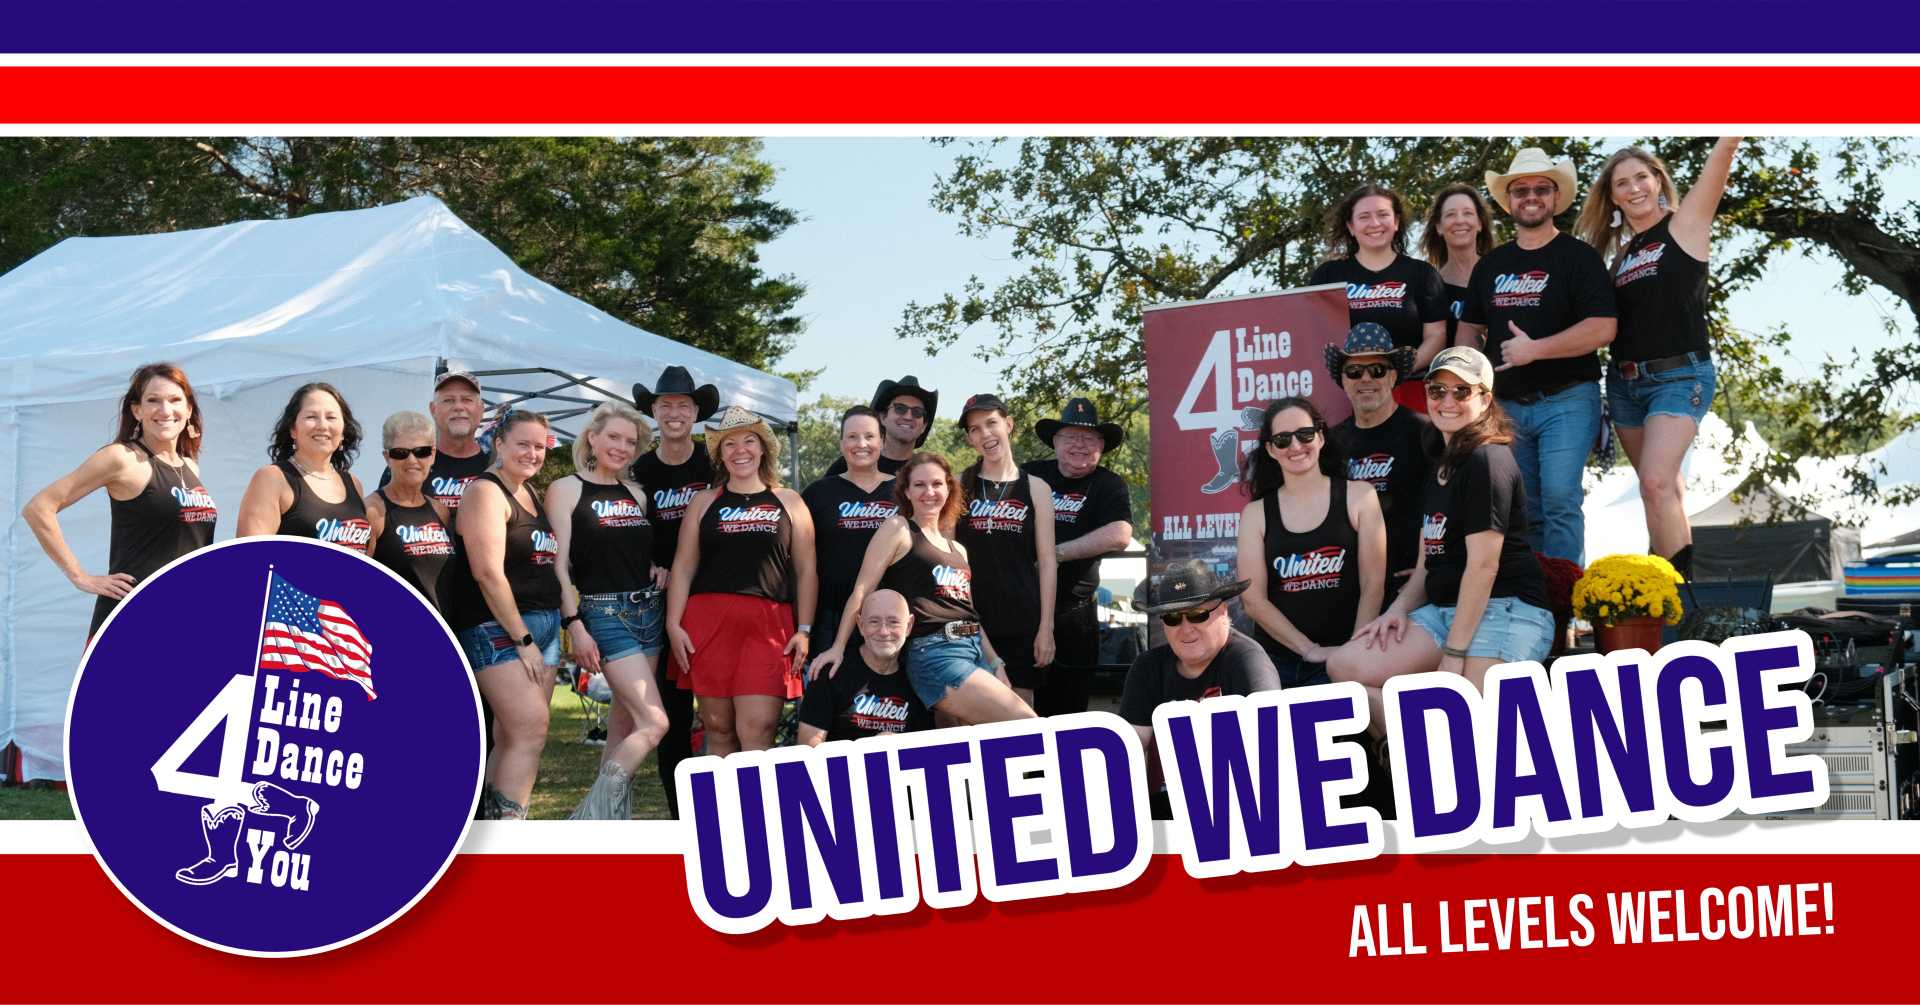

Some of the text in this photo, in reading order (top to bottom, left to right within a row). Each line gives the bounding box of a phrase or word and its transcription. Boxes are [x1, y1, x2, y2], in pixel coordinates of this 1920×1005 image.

[1628, 266, 1657, 281] DANCE
[1347, 283, 1406, 299] United
[1495, 273, 1549, 294] United
[1350, 300, 1402, 309] WE DANCE
[1495, 297, 1540, 306] WE DANCE
[1235, 326, 1291, 362] Line
[1173, 329, 1244, 431] 4
[1237, 367, 1313, 402] Dance
[432, 477, 473, 496] Uni
[654, 483, 711, 509] Unit
[1052, 491, 1087, 512] nited
[184, 512, 217, 523] WE DANC
[719, 506, 781, 522] United
[838, 501, 899, 518] United
[969, 499, 1029, 522] United
[1055, 513, 1077, 523] ANCE
[316, 518, 371, 545] United
[606, 519, 621, 527] WE
[722, 523, 778, 534] WE DANCE
[843, 520, 882, 529] WE DAN
[1163, 512, 1241, 540] ALL LEVEL
[396, 525, 450, 544] United
[410, 545, 427, 554] WE
[1274, 548, 1346, 579] United
[1284, 577, 1340, 591] WE DANCE
[853, 693, 909, 721] United
[856, 718, 871, 728] WE
